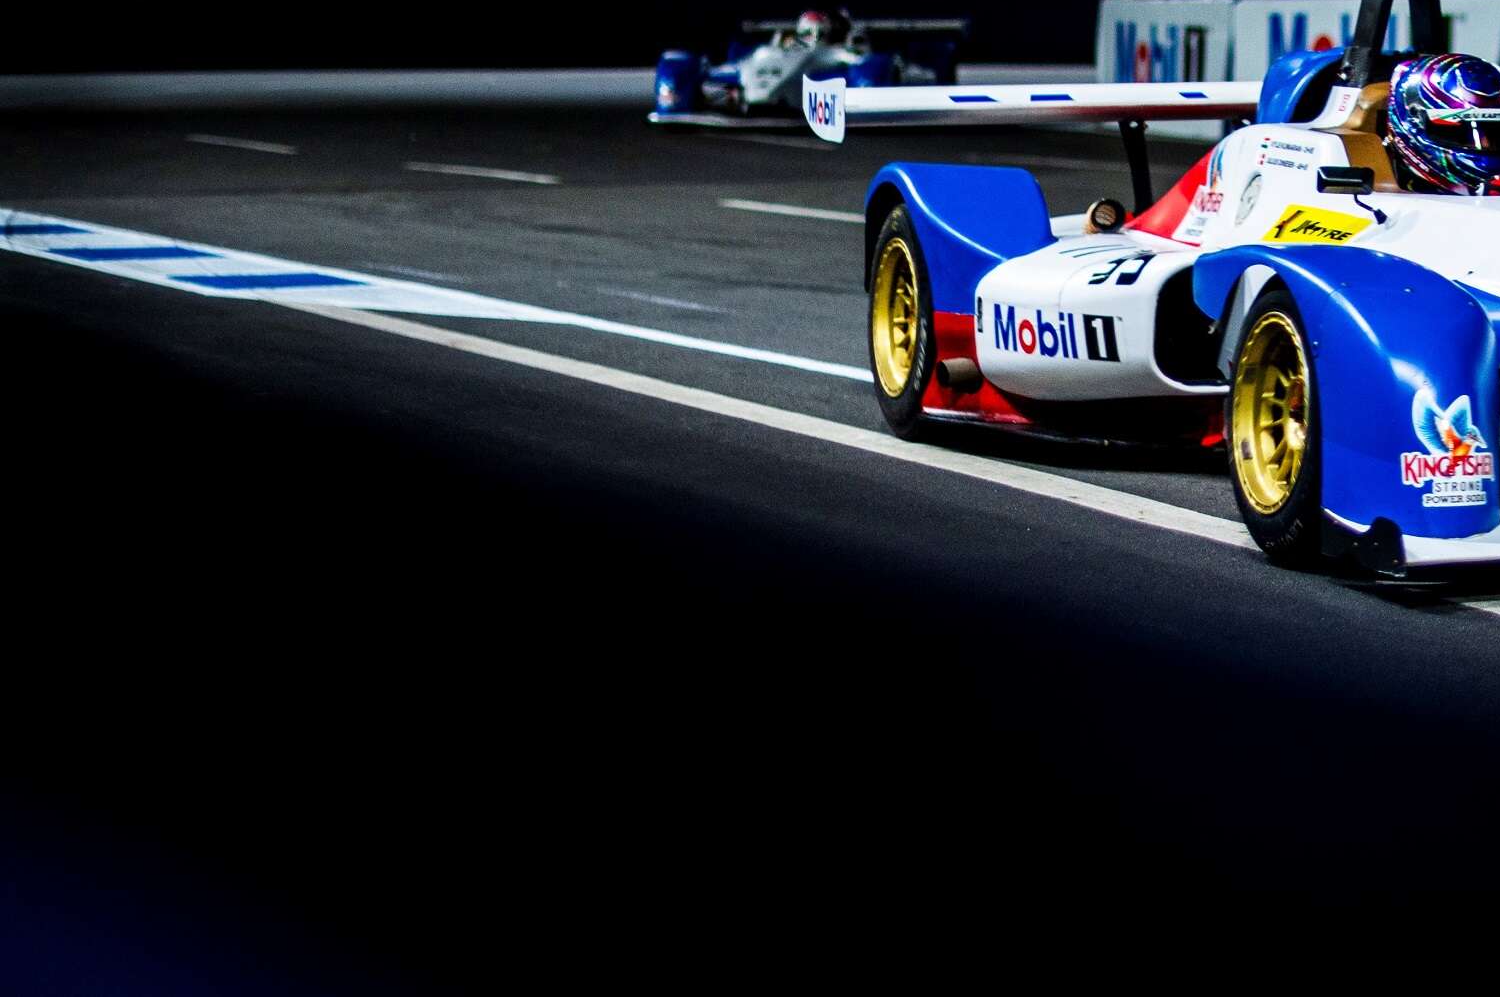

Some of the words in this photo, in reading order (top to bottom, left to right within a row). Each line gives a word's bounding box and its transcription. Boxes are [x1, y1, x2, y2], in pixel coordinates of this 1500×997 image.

[808, 91, 836, 126] Mobil
[994, 303, 1079, 359] Mobil
[1425, 494, 1464, 504] POWER
